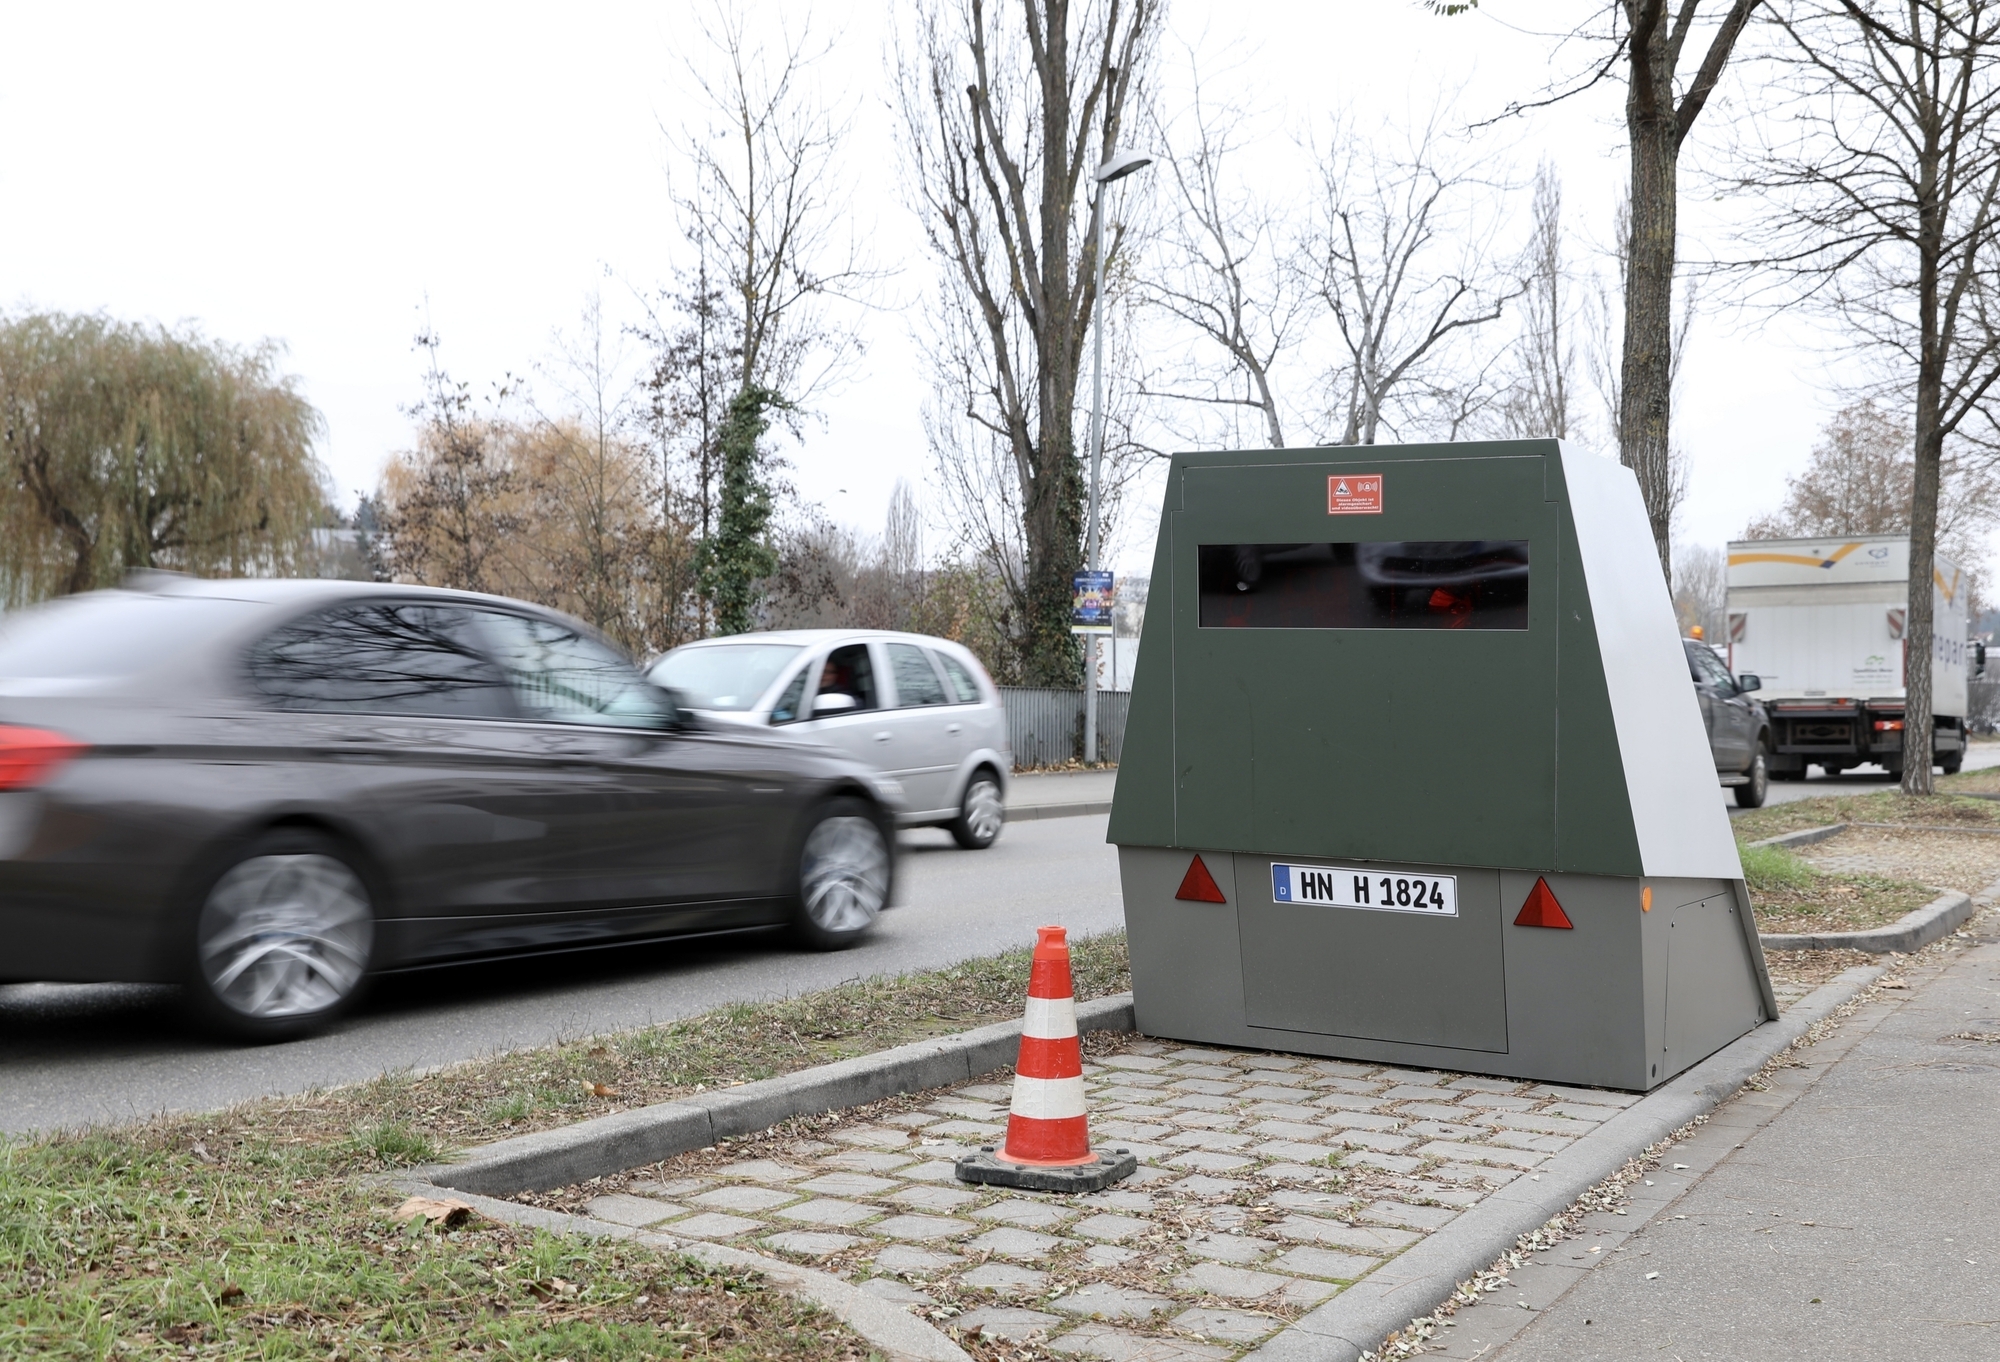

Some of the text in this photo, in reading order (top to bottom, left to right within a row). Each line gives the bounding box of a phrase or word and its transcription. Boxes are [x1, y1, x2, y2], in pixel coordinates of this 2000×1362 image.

[1280, 886, 1286, 895] D
[1301, 871, 1444, 910] HN H 1824
